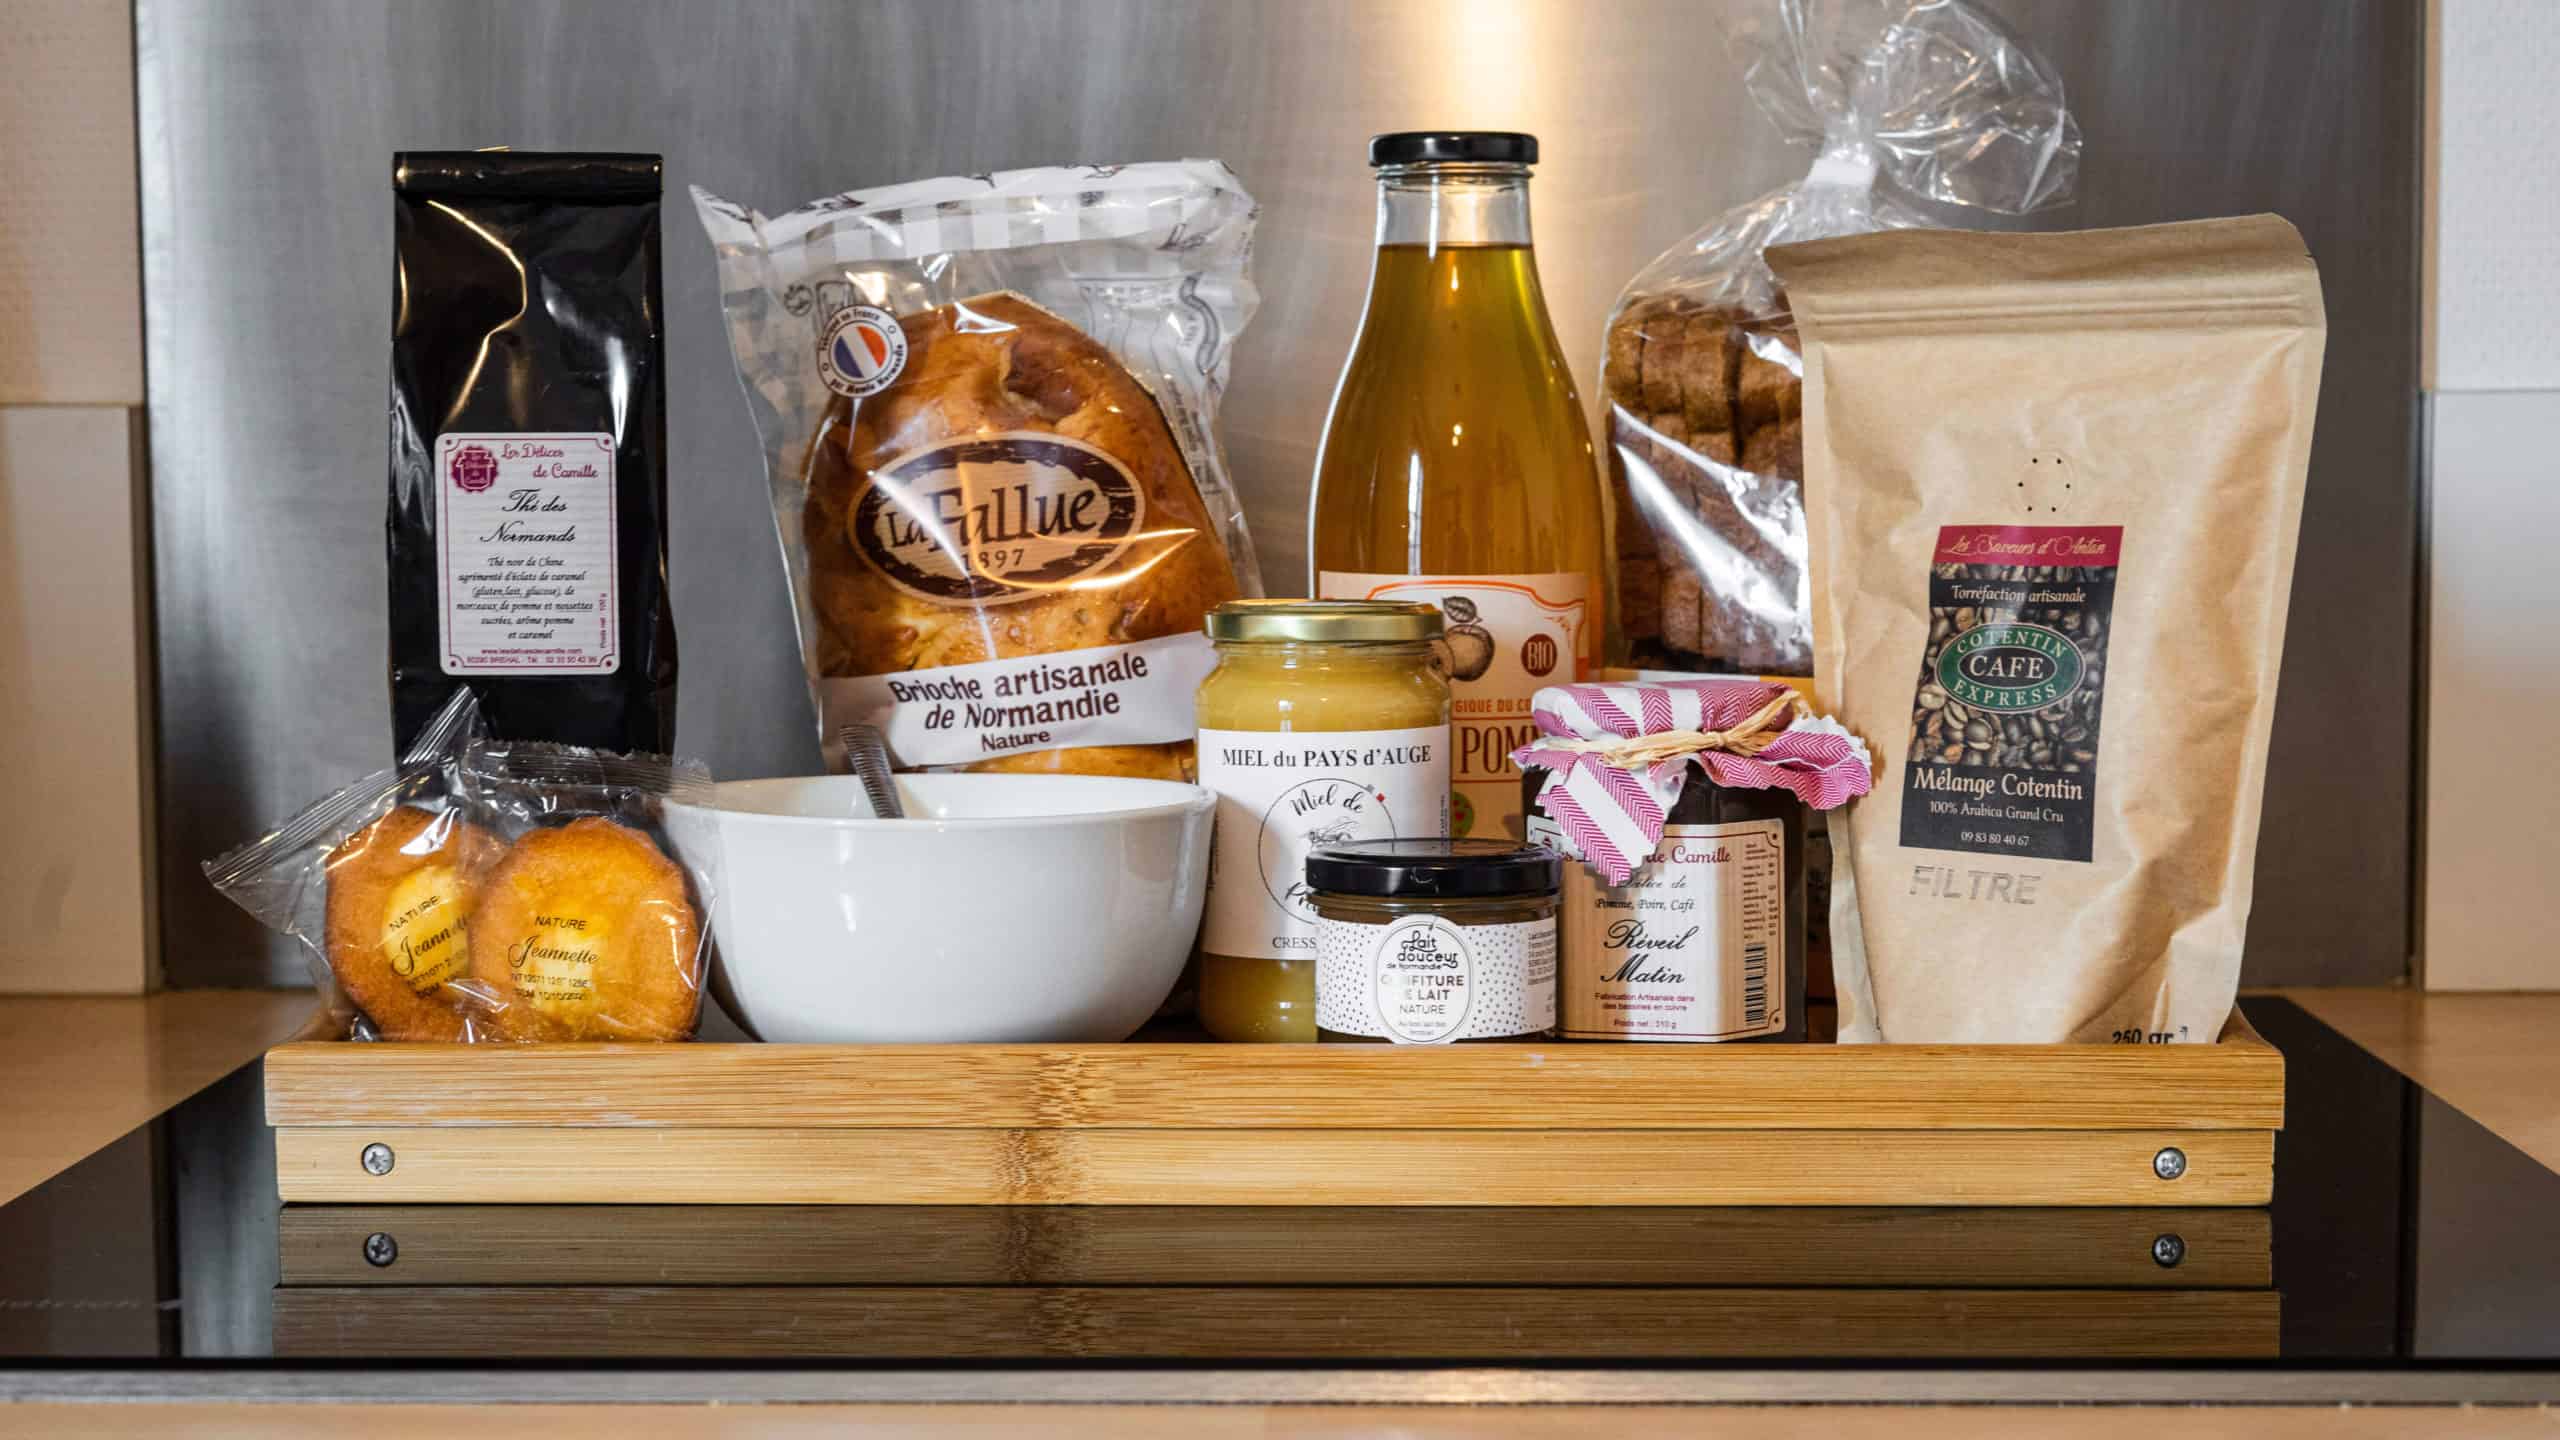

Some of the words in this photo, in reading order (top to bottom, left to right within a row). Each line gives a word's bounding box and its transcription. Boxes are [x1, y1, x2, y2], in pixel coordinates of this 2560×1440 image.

[533, 464, 548, 478] de
[552, 463, 598, 478] Camille
[502, 488, 540, 512] Thé
[541, 495, 568, 512] des
[886, 511, 927, 547] La
[926, 484, 1098, 552] Fallue
[480, 521, 576, 543] Normands
[526, 556, 536, 567] de
[539, 571, 549, 581] de
[551, 570, 587, 581] caramel
[564, 586, 575, 595] de
[1952, 584, 2026, 603] Torréfaction
[2028, 587, 2086, 602] artisanale
[500, 600, 509, 610] de
[518, 629, 555, 639] caramel
[1957, 630, 2068, 658] COTENTIN
[1527, 641, 1552, 670] BIO
[889, 677, 983, 704] Brioche
[994, 652, 1148, 697] artisanale
[1970, 655, 2044, 679] CAFE
[1953, 680, 2057, 706] EXPRESS
[924, 704, 955, 730] de
[964, 691, 1121, 729] Normandie
[1455, 699, 1491, 713] GIQUE
[1497, 699, 1513, 713] DU
[981, 730, 1051, 753] Nature
[1223, 748, 1269, 767] MIEL
[1273, 750, 1297, 767] du
[1304, 749, 1357, 767] PAYS
[1363, 745, 1432, 767] d'AUGE
[1914, 767, 1996, 800] Mélange
[2002, 774, 2083, 801] Cotentin
[1290, 784, 1338, 816] Miel
[1343, 791, 1364, 814] de
[1930, 800, 1958, 815] 100%
[1960, 803, 2002, 819] Arabica
[2006, 806, 2039, 822] Grand
[2042, 810, 2064, 823] Cru
[1961, 831, 1973, 842] 09
[1975, 832, 1988, 844] 83
[1989, 833, 2001, 844] 80
[2004, 834, 2017, 846] 40
[2018, 835, 2030, 847] 67
[1671, 844, 1731, 864] Camille
[1671, 875, 1688, 889] de
[1909, 865, 2042, 905] FILTRE
[1670, 898, 1695, 912] Café
[534, 915, 588, 931] NATURE
[1603, 919, 1700, 949] Réveil
[508, 935, 600, 969] Jeannette
[1272, 936, 1317, 949] CRESS
[1600, 953, 1685, 984] Matin
[1381, 975, 1465, 986] CFITURE
[1418, 990, 1450, 1000] LAIT
[1400, 1004, 1446, 1014] NATURE
